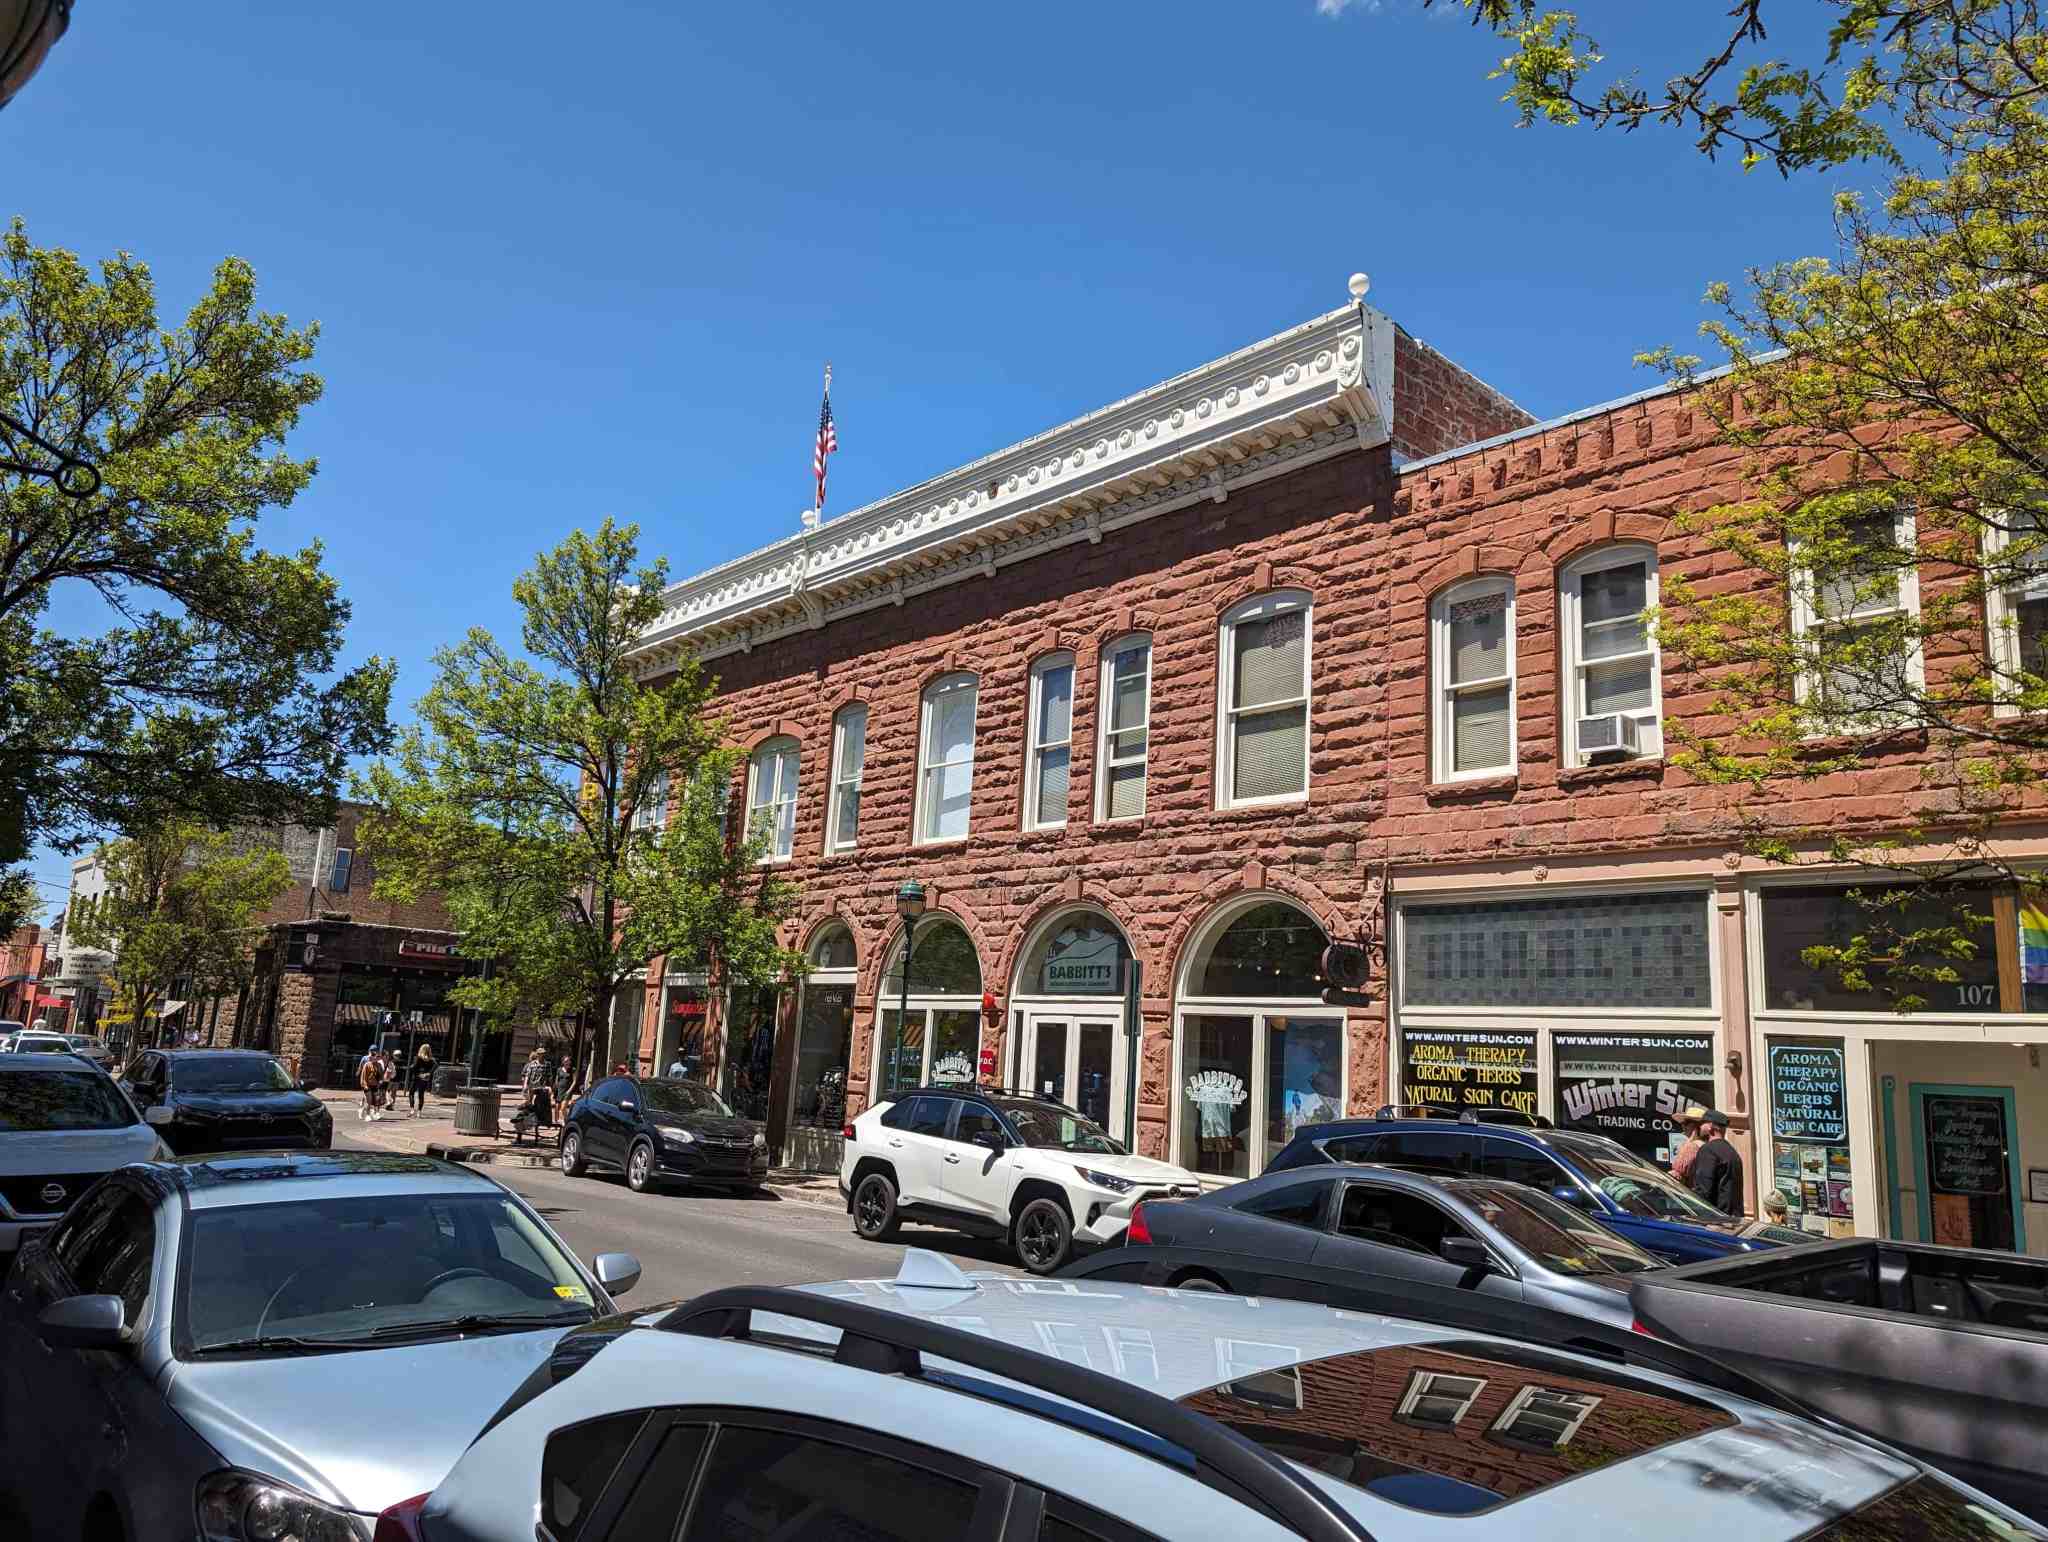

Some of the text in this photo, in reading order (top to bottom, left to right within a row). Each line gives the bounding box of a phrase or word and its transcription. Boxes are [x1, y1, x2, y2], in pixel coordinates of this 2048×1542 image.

[1957, 984, 1994, 1006] 107
[1405, 1032, 1534, 1044] WWW.WINTERSUN.COM
[1556, 1036, 1709, 1048] WWW.WINTERSUN.COM
[1412, 1045, 1527, 1063] AROMA THERAPY
[1781, 1053, 1832, 1065] AROMA
[1417, 1065, 1522, 1085] ORGANIC HERBS
[1776, 1066, 1837, 1078] THERAPY
[1778, 1080, 1839, 1092] ORGANIC
[1404, 1085, 1456, 1111] NATURAL
[1463, 1088, 1494, 1105] SKIN
[1562, 1076, 1709, 1121] Winter Su
[1783, 1093, 1832, 1105] HERBS
[1776, 1107, 1842, 1120] NATURAL
[1597, 1115, 1645, 1129] TRADING
[1776, 1120, 1842, 1133] SKIN CARE
